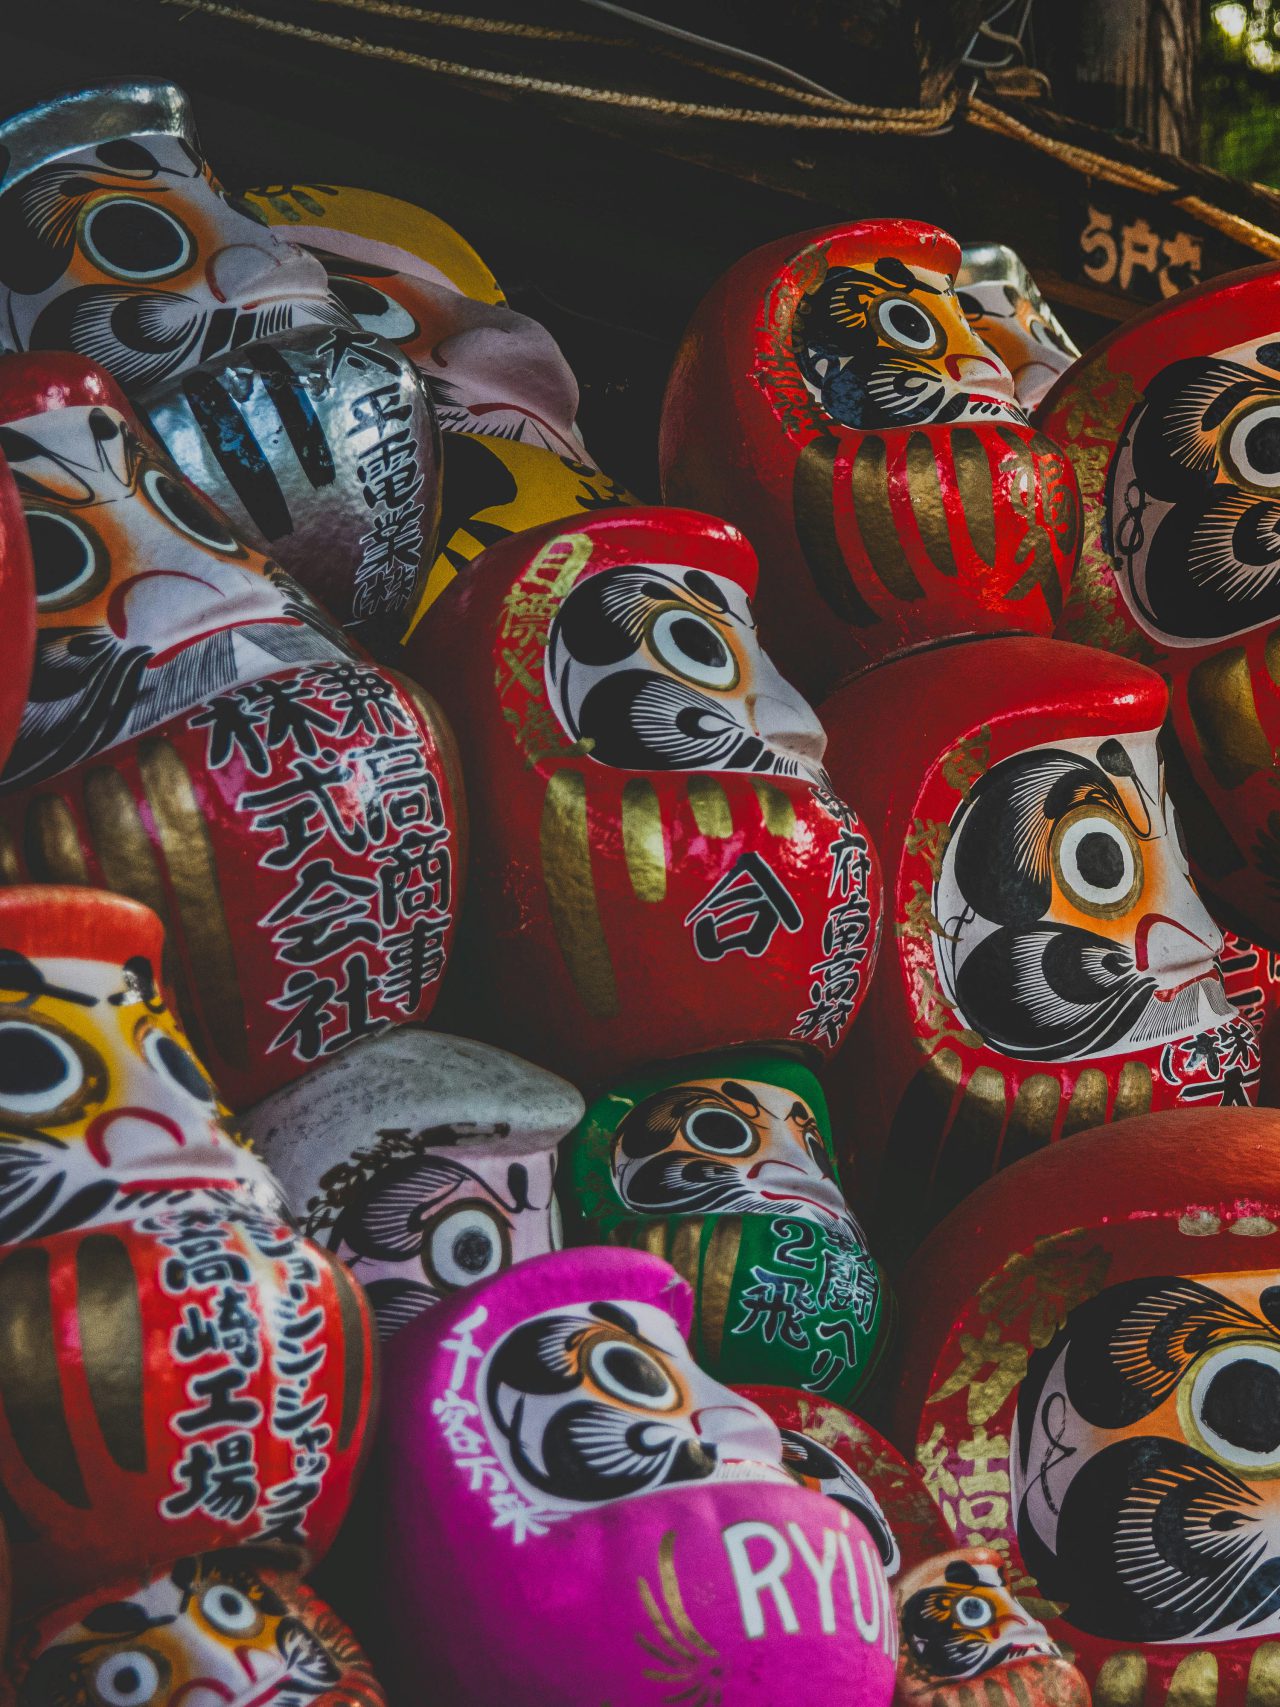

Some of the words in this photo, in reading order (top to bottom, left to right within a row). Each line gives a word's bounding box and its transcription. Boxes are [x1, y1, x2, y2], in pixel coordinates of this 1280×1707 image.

[188, 678, 391, 1062] 株式会社
[684, 851, 803, 961] 合
[159, 1229, 262, 1527] 高崎工場
[431, 1304, 558, 1546] 千客万来
